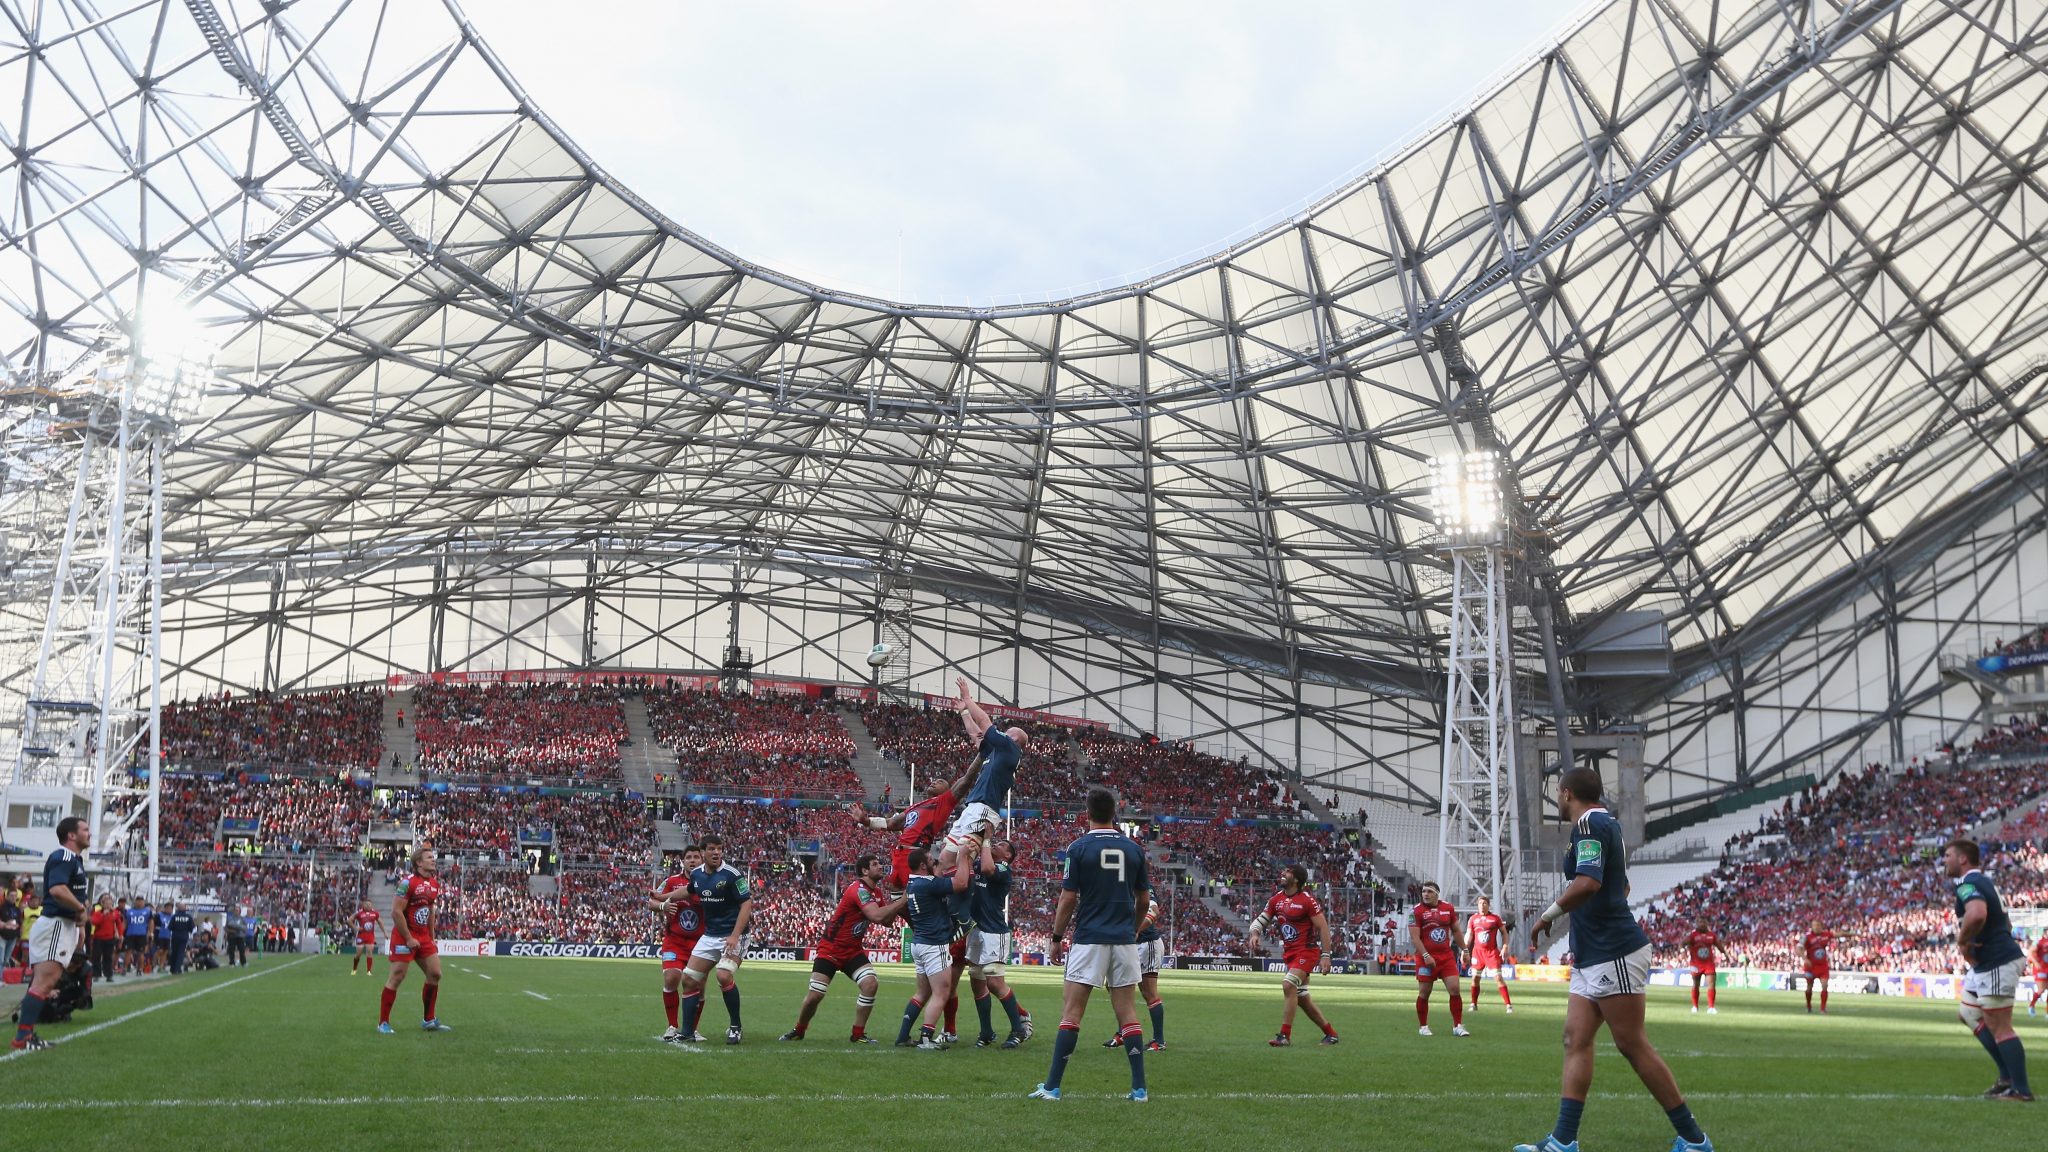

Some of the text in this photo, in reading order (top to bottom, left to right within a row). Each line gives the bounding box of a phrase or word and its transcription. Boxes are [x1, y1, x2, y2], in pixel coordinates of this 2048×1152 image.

[836, 687, 862, 697] SSION
[1101, 849, 1125, 882] 9
[908, 894, 920, 914] 7
[444, 942, 489, 955] france 2
[510, 943, 663, 958] ERCRUGBYTRAVEL.C
[747, 949, 796, 961] adidas
[868, 951, 897, 963] RMC
[1011, 953, 1041, 966] dEx
[1188, 963, 1203, 971] THE
[1231, 964, 1252, 972] TIMES
